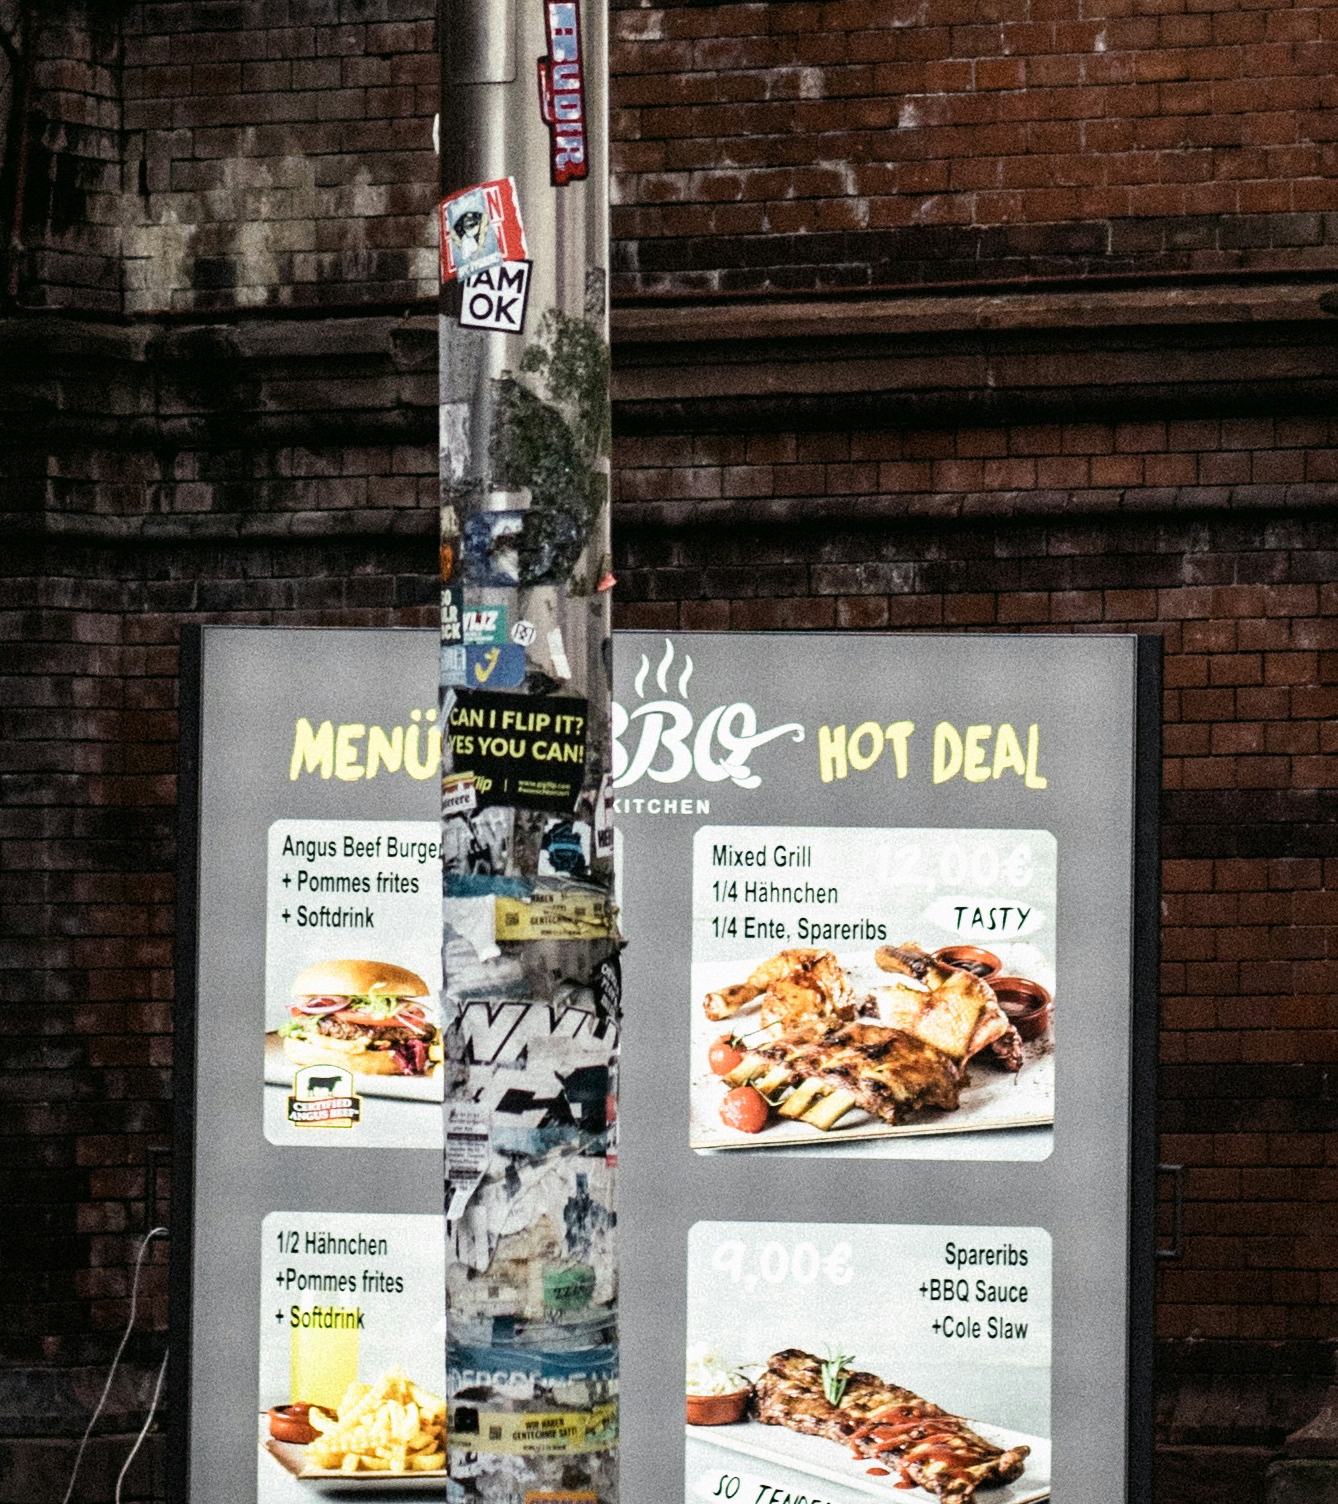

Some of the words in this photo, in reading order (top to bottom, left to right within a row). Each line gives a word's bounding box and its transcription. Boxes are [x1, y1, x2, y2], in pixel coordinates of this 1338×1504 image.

[472, 267, 525, 294] AM
[469, 293, 519, 325] OK
[450, 707, 484, 728] CAN
[489, 709, 496, 729] I
[502, 710, 551, 732] FLIP
[555, 714, 584, 736] IT?
[289, 708, 442, 782] MENÜ
[478, 736, 526, 759] YOU
[532, 740, 585, 764] CAN!
[818, 720, 915, 784] HOT
[932, 721, 1049, 790] DEAL
[282, 835, 337, 862] Angus
[343, 836, 382, 858] Beef
[712, 844, 766, 867] Mixed
[773, 845, 811, 868] Grill
[297, 870, 371, 893] Pommes
[377, 872, 419, 894] frites
[712, 880, 738, 903] 1/4
[744, 880, 839, 904] Hähnchen
[297, 905, 375, 929] Softdrink
[712, 916, 738, 939] 1/4
[744, 917, 791, 942] Ente,
[798, 918, 888, 945] Spareribs
[954, 906, 1032, 931] TASTY
[276, 1230, 300, 1254] 1/2
[305, 1231, 388, 1255] Hähnchen
[711, 1239, 855, 1291] 9,00€
[945, 1242, 1029, 1271] Spareribs
[276, 1267, 357, 1293] +Pommes
[362, 1270, 404, 1294] frites
[919, 1278, 969, 1303] +BBQ
[975, 1279, 1029, 1304] Sauce
[290, 1305, 365, 1329] Softdrink
[932, 1315, 981, 1339] +Cole
[987, 1316, 1029, 1340] Slaw
[713, 1474, 741, 1499] SO
